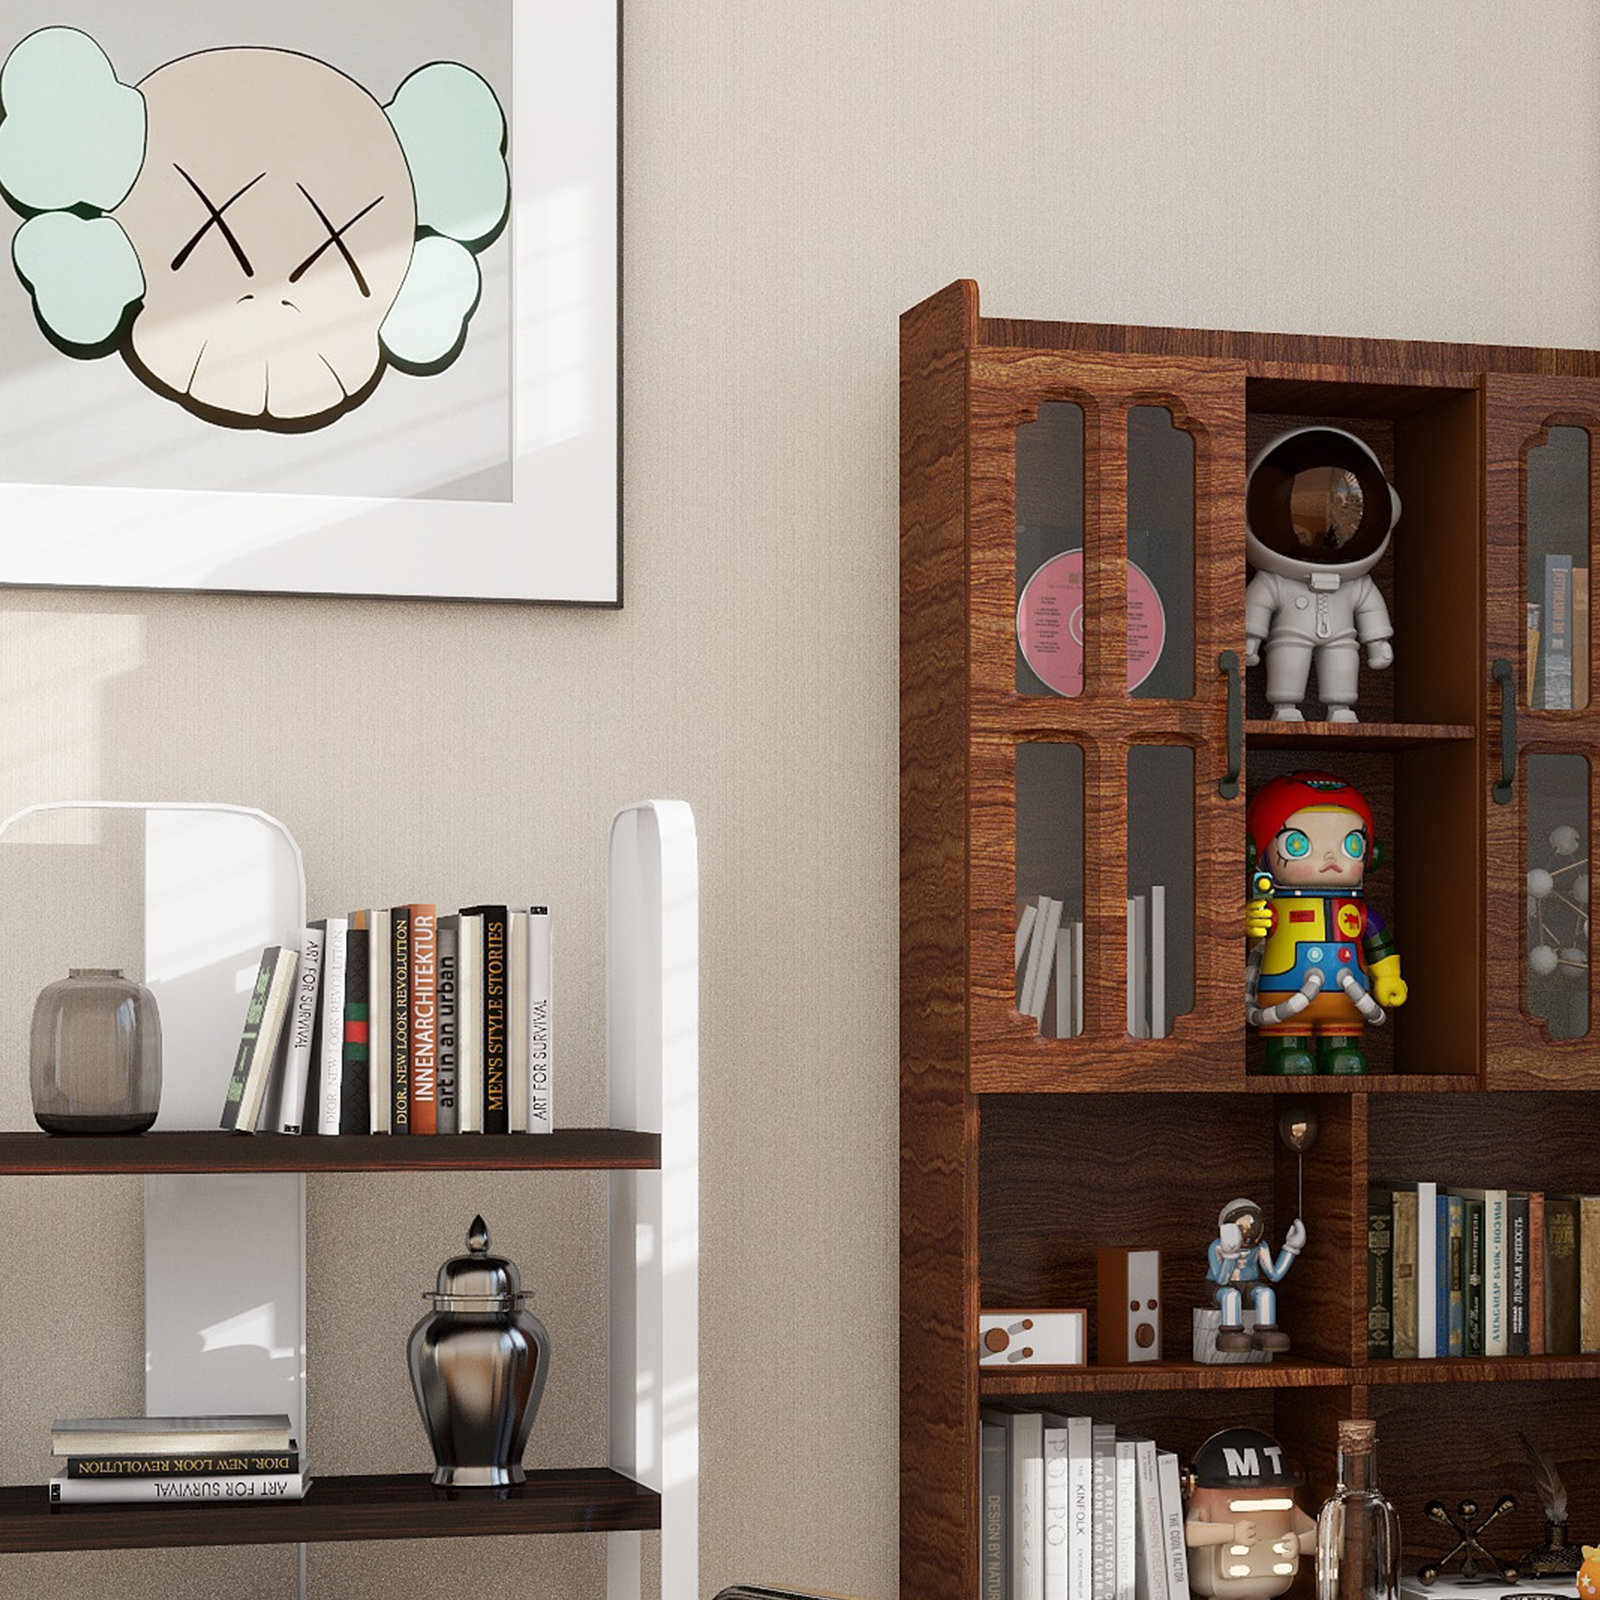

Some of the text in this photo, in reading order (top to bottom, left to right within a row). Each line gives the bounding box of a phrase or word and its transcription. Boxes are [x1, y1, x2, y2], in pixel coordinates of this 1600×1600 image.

[294, 940, 319, 1049] ART FOR SURVIVAL
[330, 930, 344, 1014] REVOLUTION
[397, 919, 408, 1125] DIOR. NEW LOOK REVOLUTION
[415, 915, 435, 1101] INNENARCHITEKTUR
[437, 956, 454, 1108] art in an urban
[488, 921, 503, 1111] MEN'S STYLE STORIES
[329, 1019, 340, 1052] LOOK
[533, 1000, 547, 1120] ART FOR SURVIVAL
[328, 1059, 338, 1087] NEW
[1514, 1217, 1524, 1264] КРЕПОСТЬ
[1492, 1201, 1502, 1342] АЛЕКСАНДР БЛОК ПОЭМЫ
[1513, 1266, 1523, 1303] ЛЕСНАЯ
[79, 1457, 289, 1474] DIOR. NEW LOOK REVOLUTION
[154, 1482, 288, 1497] ART FOR SURVIVAL
[1095, 1451, 1104, 1517] EVERYONE
[1104, 1475, 1113, 1483] A
[988, 1496, 1000, 1540] DESIGN
[1076, 1484, 1085, 1536] KINFOLK
[1104, 1490, 1113, 1523] BRIEF
[988, 1543, 1000, 1560] BY
[1095, 1525, 1104, 1551] WHO
[1104, 1533, 1113, 1586] HISTORY
[1169, 1512, 1185, 1584] THE COOL FACTOR
[1095, 1558, 1104, 1588] EVER
